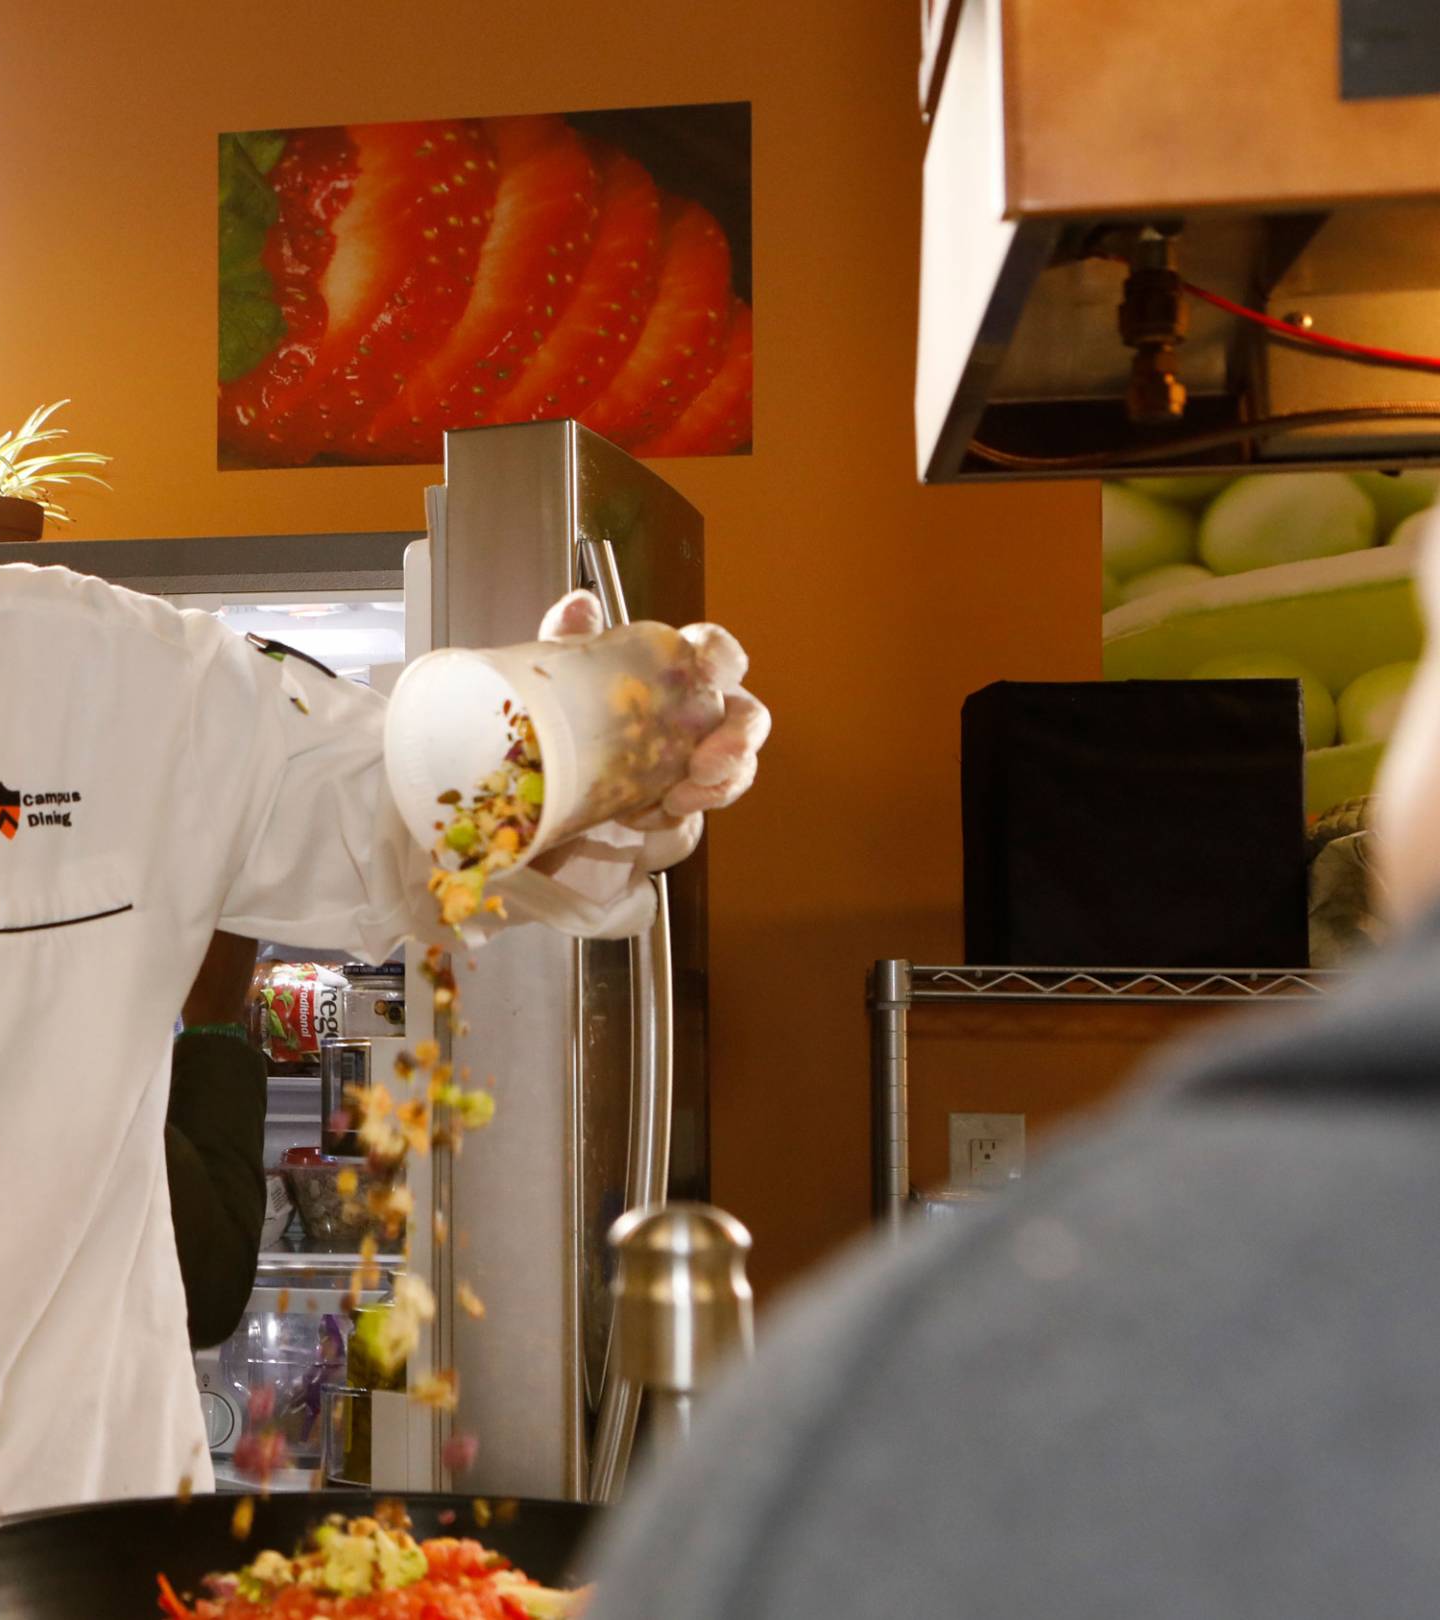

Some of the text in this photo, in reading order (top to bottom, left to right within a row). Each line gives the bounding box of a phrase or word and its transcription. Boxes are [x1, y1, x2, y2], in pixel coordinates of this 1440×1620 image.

[22, 791, 82, 807] Campus
[27, 810, 72, 828] Dining
[299, 984, 312, 1038] raditional
